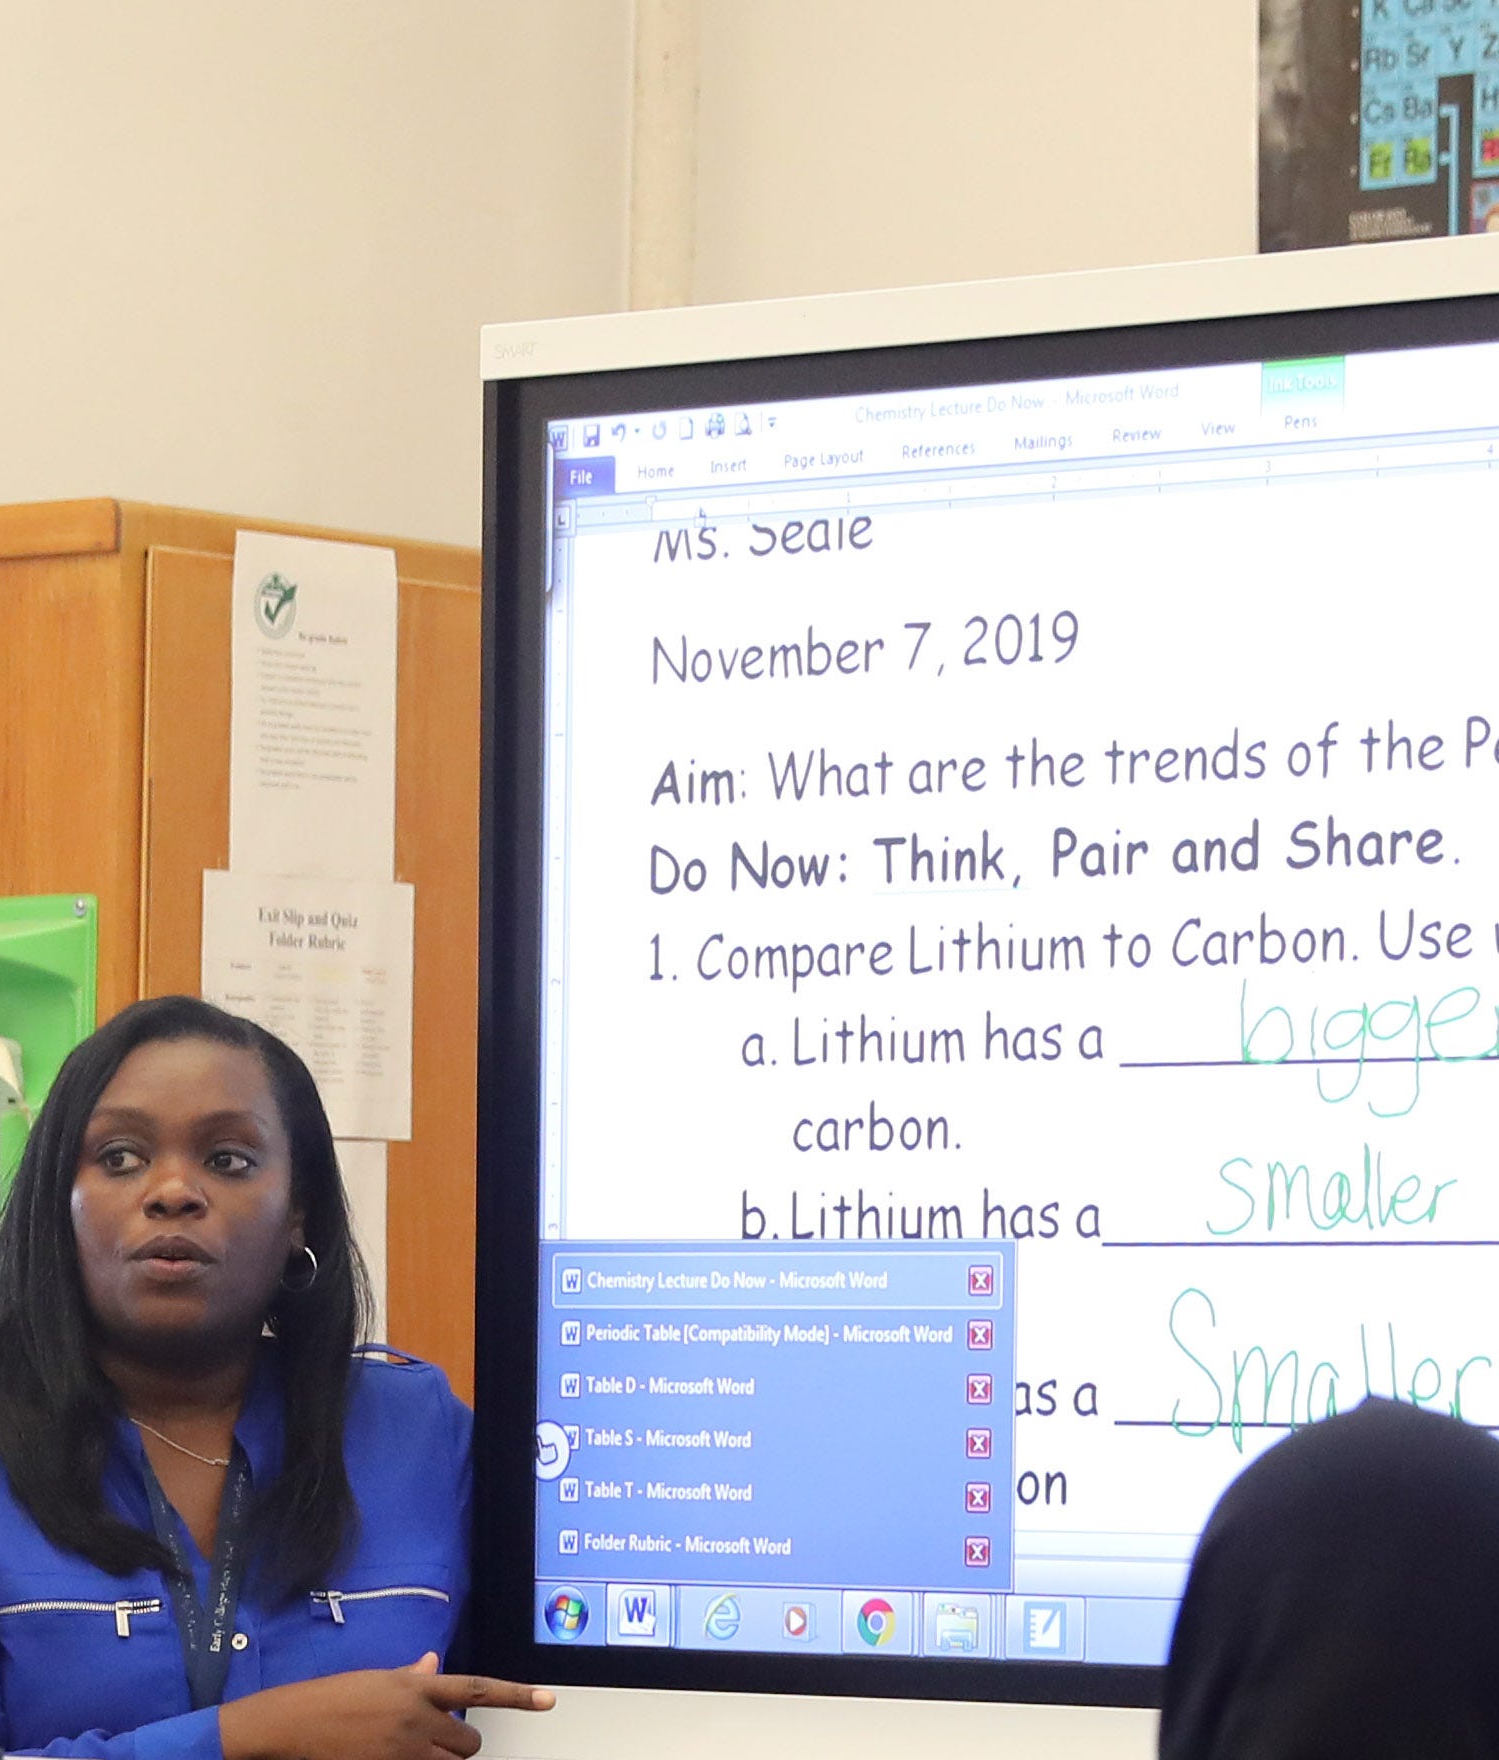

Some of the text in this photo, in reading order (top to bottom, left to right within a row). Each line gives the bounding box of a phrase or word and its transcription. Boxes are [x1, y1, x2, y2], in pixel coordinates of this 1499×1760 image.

[855, 382, 1180, 424] Chemistry Lecture Do Now Microsoft Word
[570, 413, 1318, 486] File Home Insert Page Layout References Mailings Review View Pens
[652, 610, 1080, 684] November 7, 2019
[651, 759, 748, 806] Aim:
[767, 747, 894, 801] What
[908, 756, 987, 795] are
[1005, 738, 1086, 792] the
[1104, 728, 1267, 785] trends
[1287, 722, 1339, 778] of
[1359, 719, 1446, 774] the
[650, 815, 1461, 895] Do Now: Think, Pair and Share.
[650, 934, 678, 982] 1.
[697, 932, 894, 993] Compare
[909, 921, 1086, 974] Lithium
[1103, 923, 1152, 970] to
[1172, 911, 1358, 968] Carbon.
[1378, 907, 1473, 961] Use
[741, 1011, 1105, 1067] a. Lithium has a
[792, 1100, 963, 1152] carbon.
[741, 1189, 1103, 1239] b. Lithium has a
[1206, 1143, 1458, 1235] smaller
[587, 1271, 888, 1294] Chemistry Lecture Do Now Microsoft Word
[586, 1324, 953, 1346] Periodic Table [Compatibility Mode] Microsoft Word
[586, 1377, 755, 1396] Table D Microsoft Word
[1168, 1288, 1493, 1454] Smaller
[1015, 1378, 1100, 1418] as a
[585, 1429, 752, 1449] Table S Microsoft Word
[585, 1481, 753, 1502] Table T Microsoft Word
[584, 1533, 792, 1556] Folder Rubric Microsoft Word
